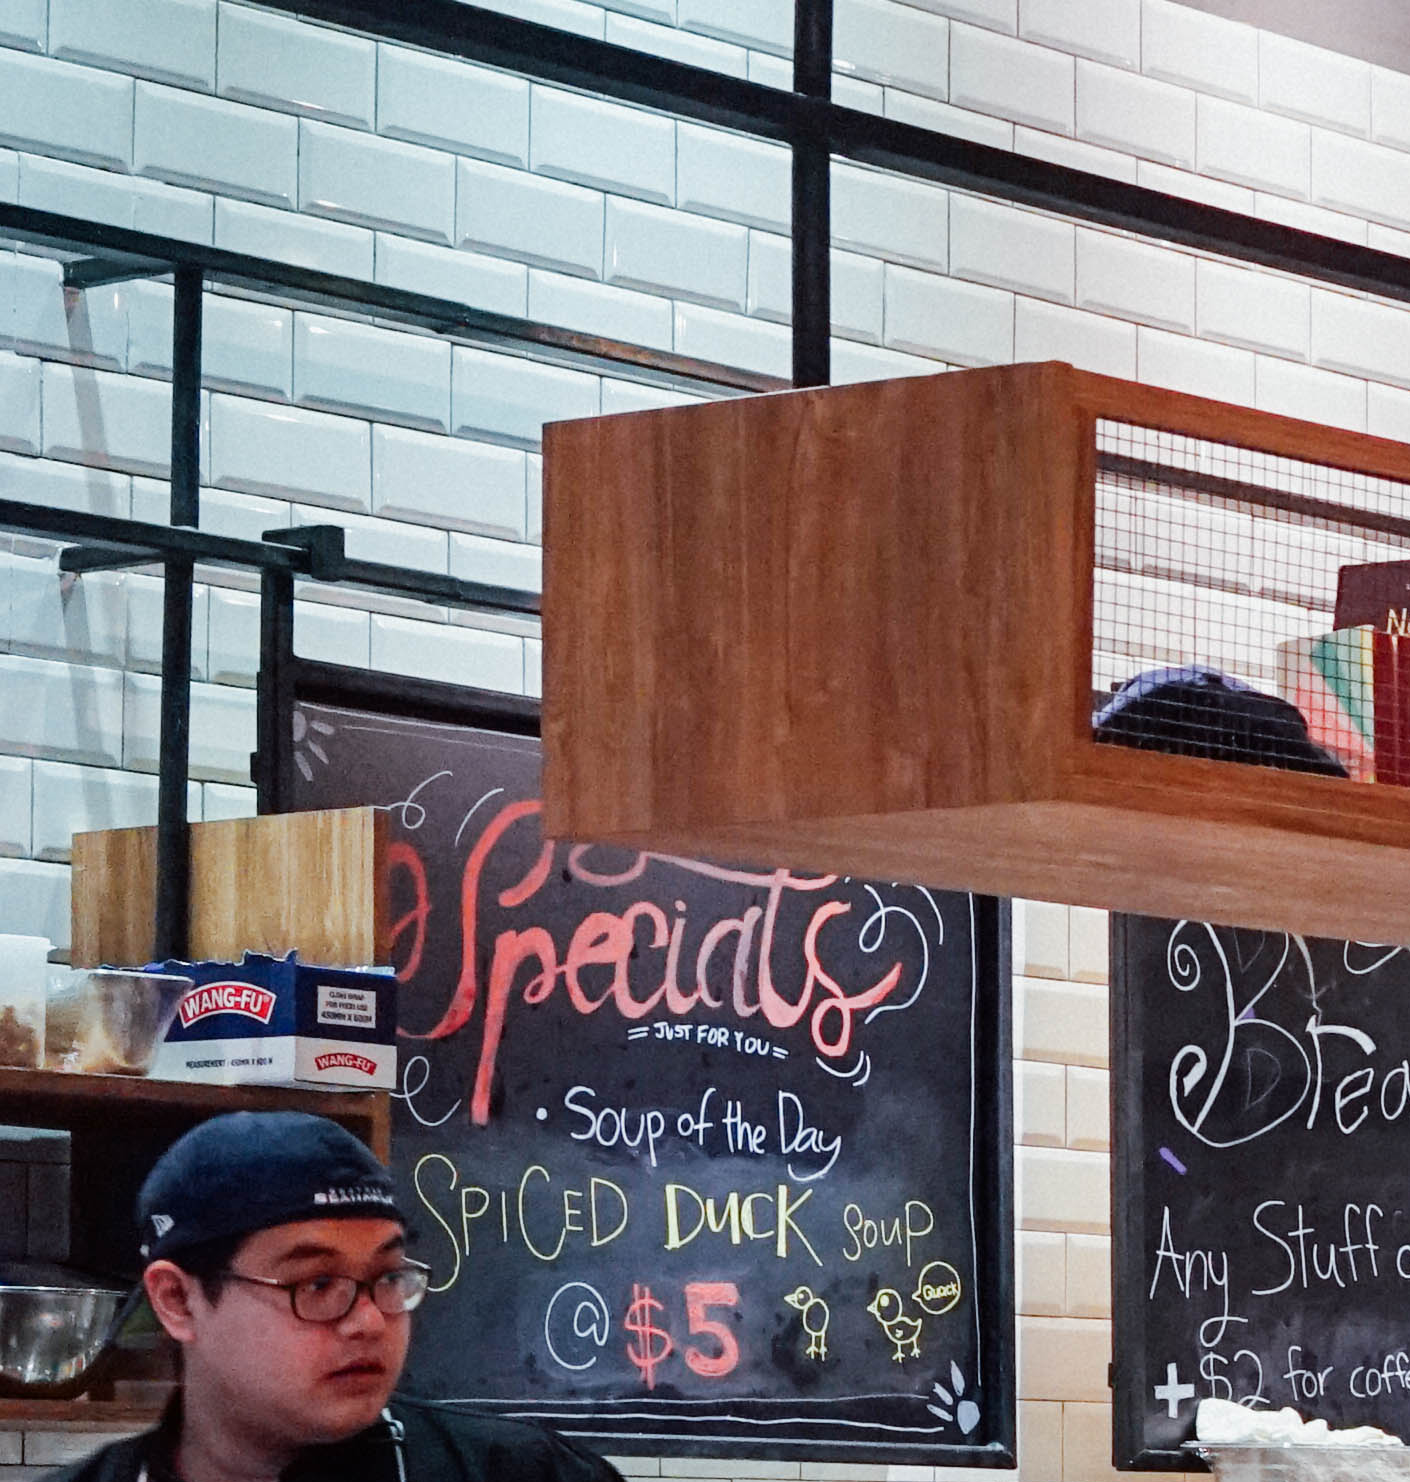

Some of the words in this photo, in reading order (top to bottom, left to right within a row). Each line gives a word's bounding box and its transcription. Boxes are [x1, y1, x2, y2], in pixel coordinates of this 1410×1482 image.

[392, 800, 902, 1125] Specials
[184, 987, 262, 1019] WANG-FU
[653, 1021, 693, 1041] JUST
[697, 1024, 730, 1047] FOR
[733, 1031, 771, 1056] YOU
[316, 1054, 373, 1071] WANG-FU
[565, 1086, 665, 1167] Soup
[678, 1088, 716, 1145] of
[722, 1101, 767, 1154] the
[778, 1091, 842, 1181] Day
[1149, 1206, 1249, 1348] Any
[1252, 1200, 1384, 1296] Stuff
[544, 1282, 609, 1371] @
[624, 1281, 742, 1392] $5
[1200, 1349, 1271, 1408] $2
[1283, 1345, 1334, 1401] for
